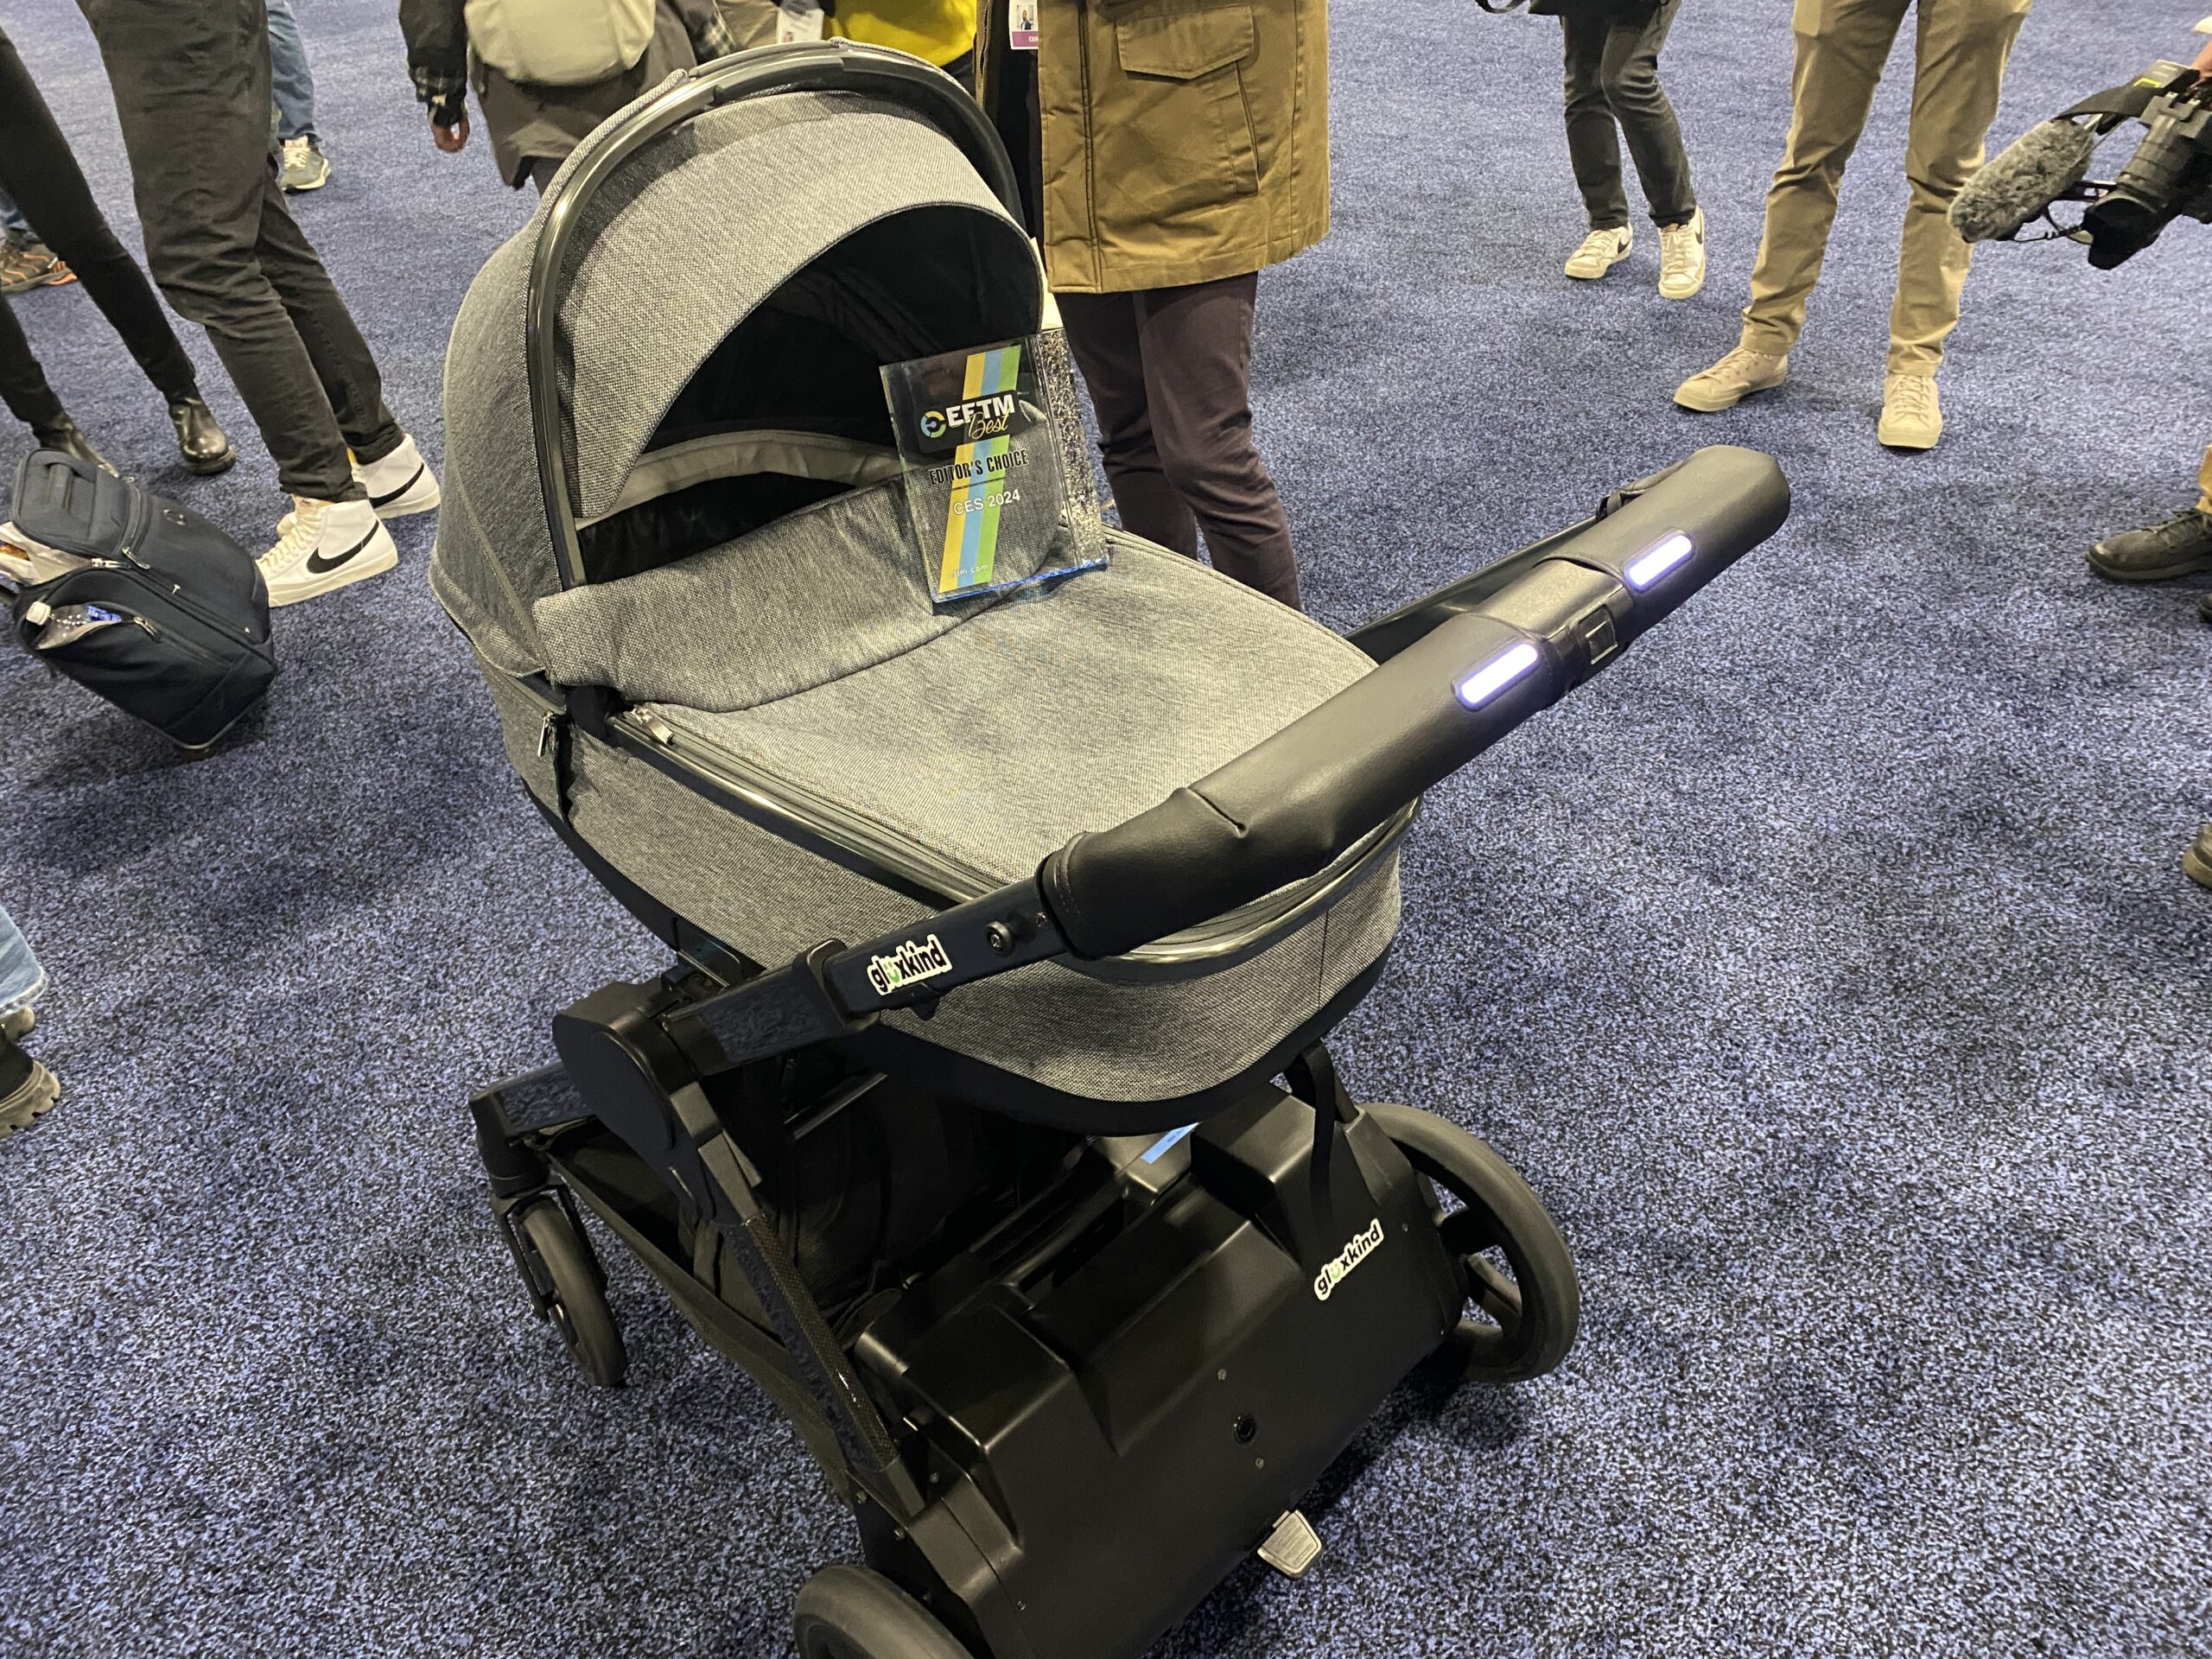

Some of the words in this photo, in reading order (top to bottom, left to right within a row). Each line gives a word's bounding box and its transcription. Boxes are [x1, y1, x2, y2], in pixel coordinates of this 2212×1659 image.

[946, 395, 1015, 428] EFTM
[968, 412, 1009, 439] Best
[929, 460, 982, 486] EDITOR'S
[987, 449, 1028, 473] CHOICE
[953, 498, 983, 515] CES
[988, 489, 1020, 507] 2024
